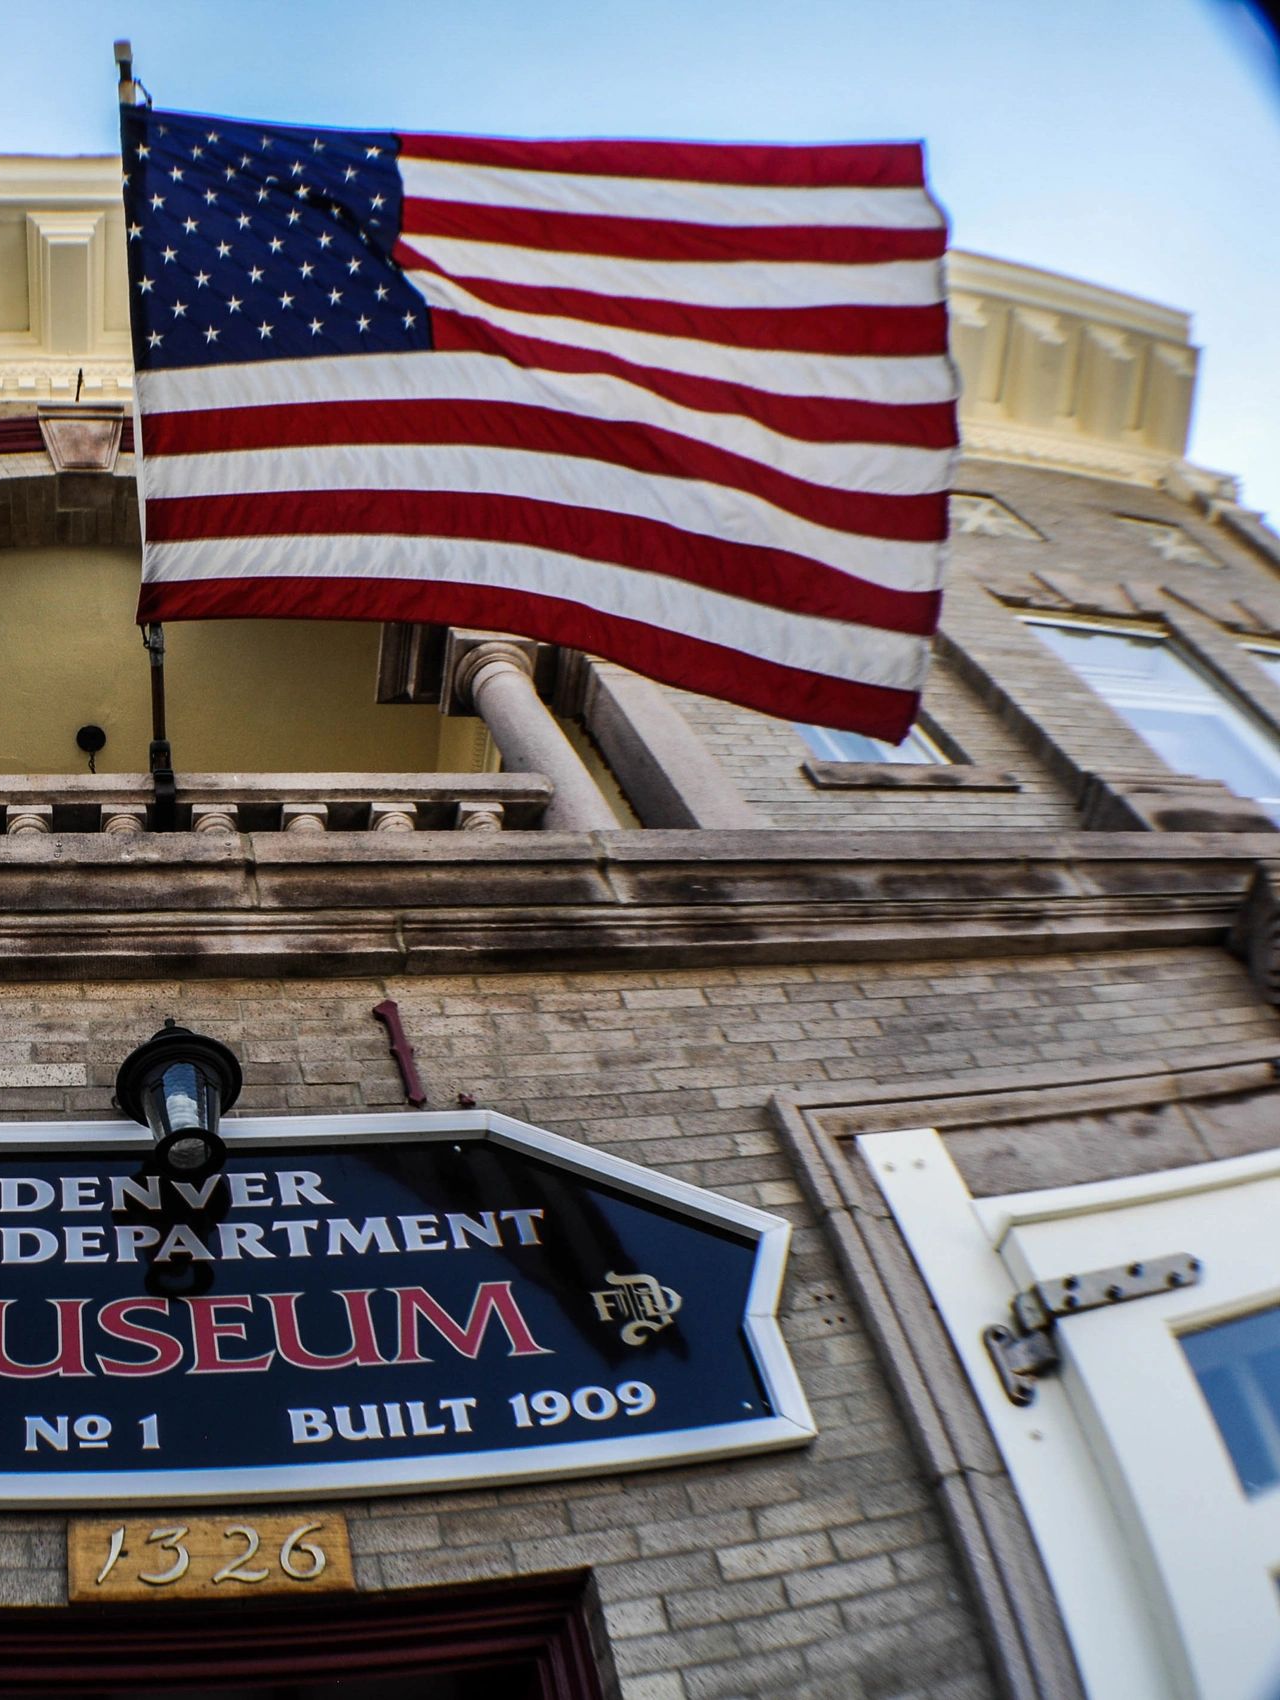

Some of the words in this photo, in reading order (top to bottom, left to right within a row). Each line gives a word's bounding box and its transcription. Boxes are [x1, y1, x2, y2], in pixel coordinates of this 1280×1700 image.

[0, 1209, 544, 1264] DEPARTMENT
[138, 1412, 160, 1449] 1
[289, 1397, 477, 1445] BUILT
[510, 1380, 657, 1430] 1909
[96, 1522, 326, 1585] 1326
